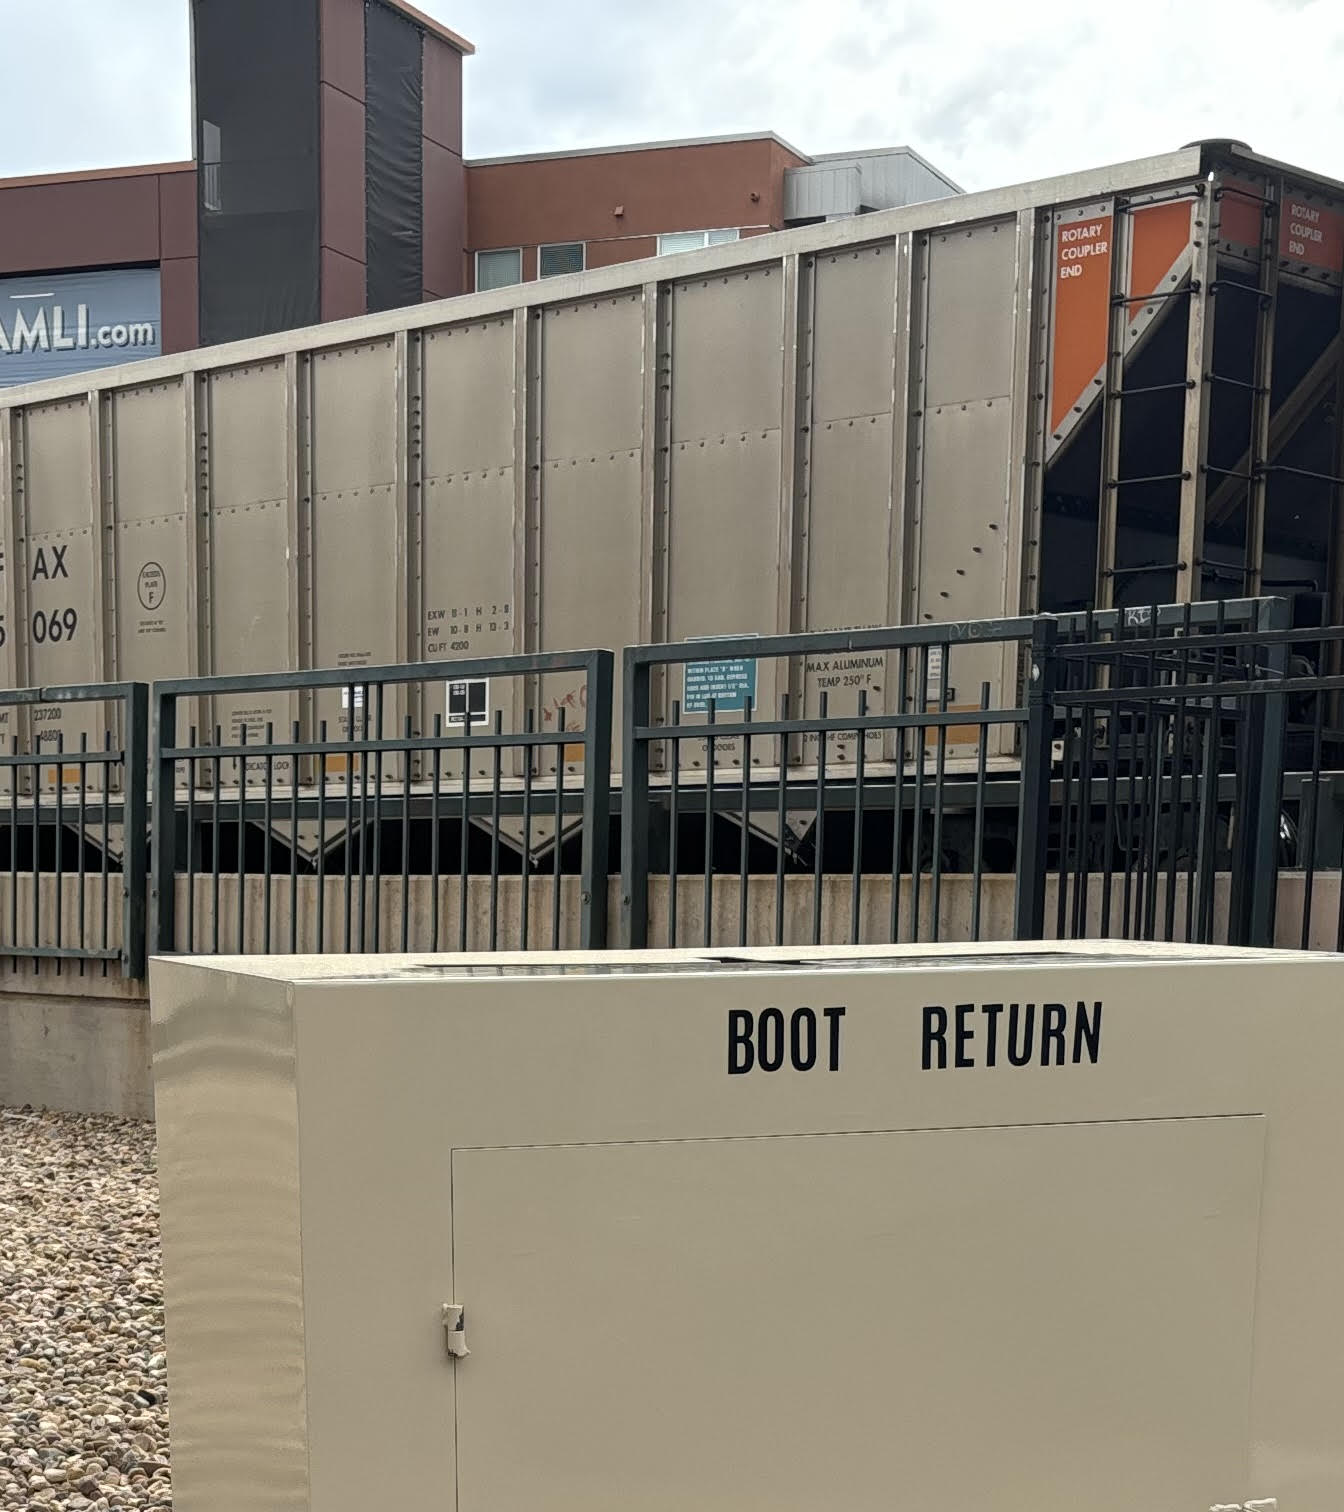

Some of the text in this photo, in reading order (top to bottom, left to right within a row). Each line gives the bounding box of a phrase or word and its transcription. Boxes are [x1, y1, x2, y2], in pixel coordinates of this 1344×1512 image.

[1291, 204, 1320, 223] ROTARY
[1061, 224, 1103, 242] ROTARY
[1290, 223, 1323, 242] COUPLER
[1061, 242, 1108, 260] COUPLER
[1288, 240, 1305, 256] END
[1060, 264, 1082, 278] END
[32, 545, 69, 581] AX
[148, 592, 154, 604] F
[33, 608, 77, 643] 069
[805, 656, 883, 672] MAX ALUMINUM
[818, 677, 841, 687] TEMP
[728, 1001, 1103, 1074] BOOT RETURN
